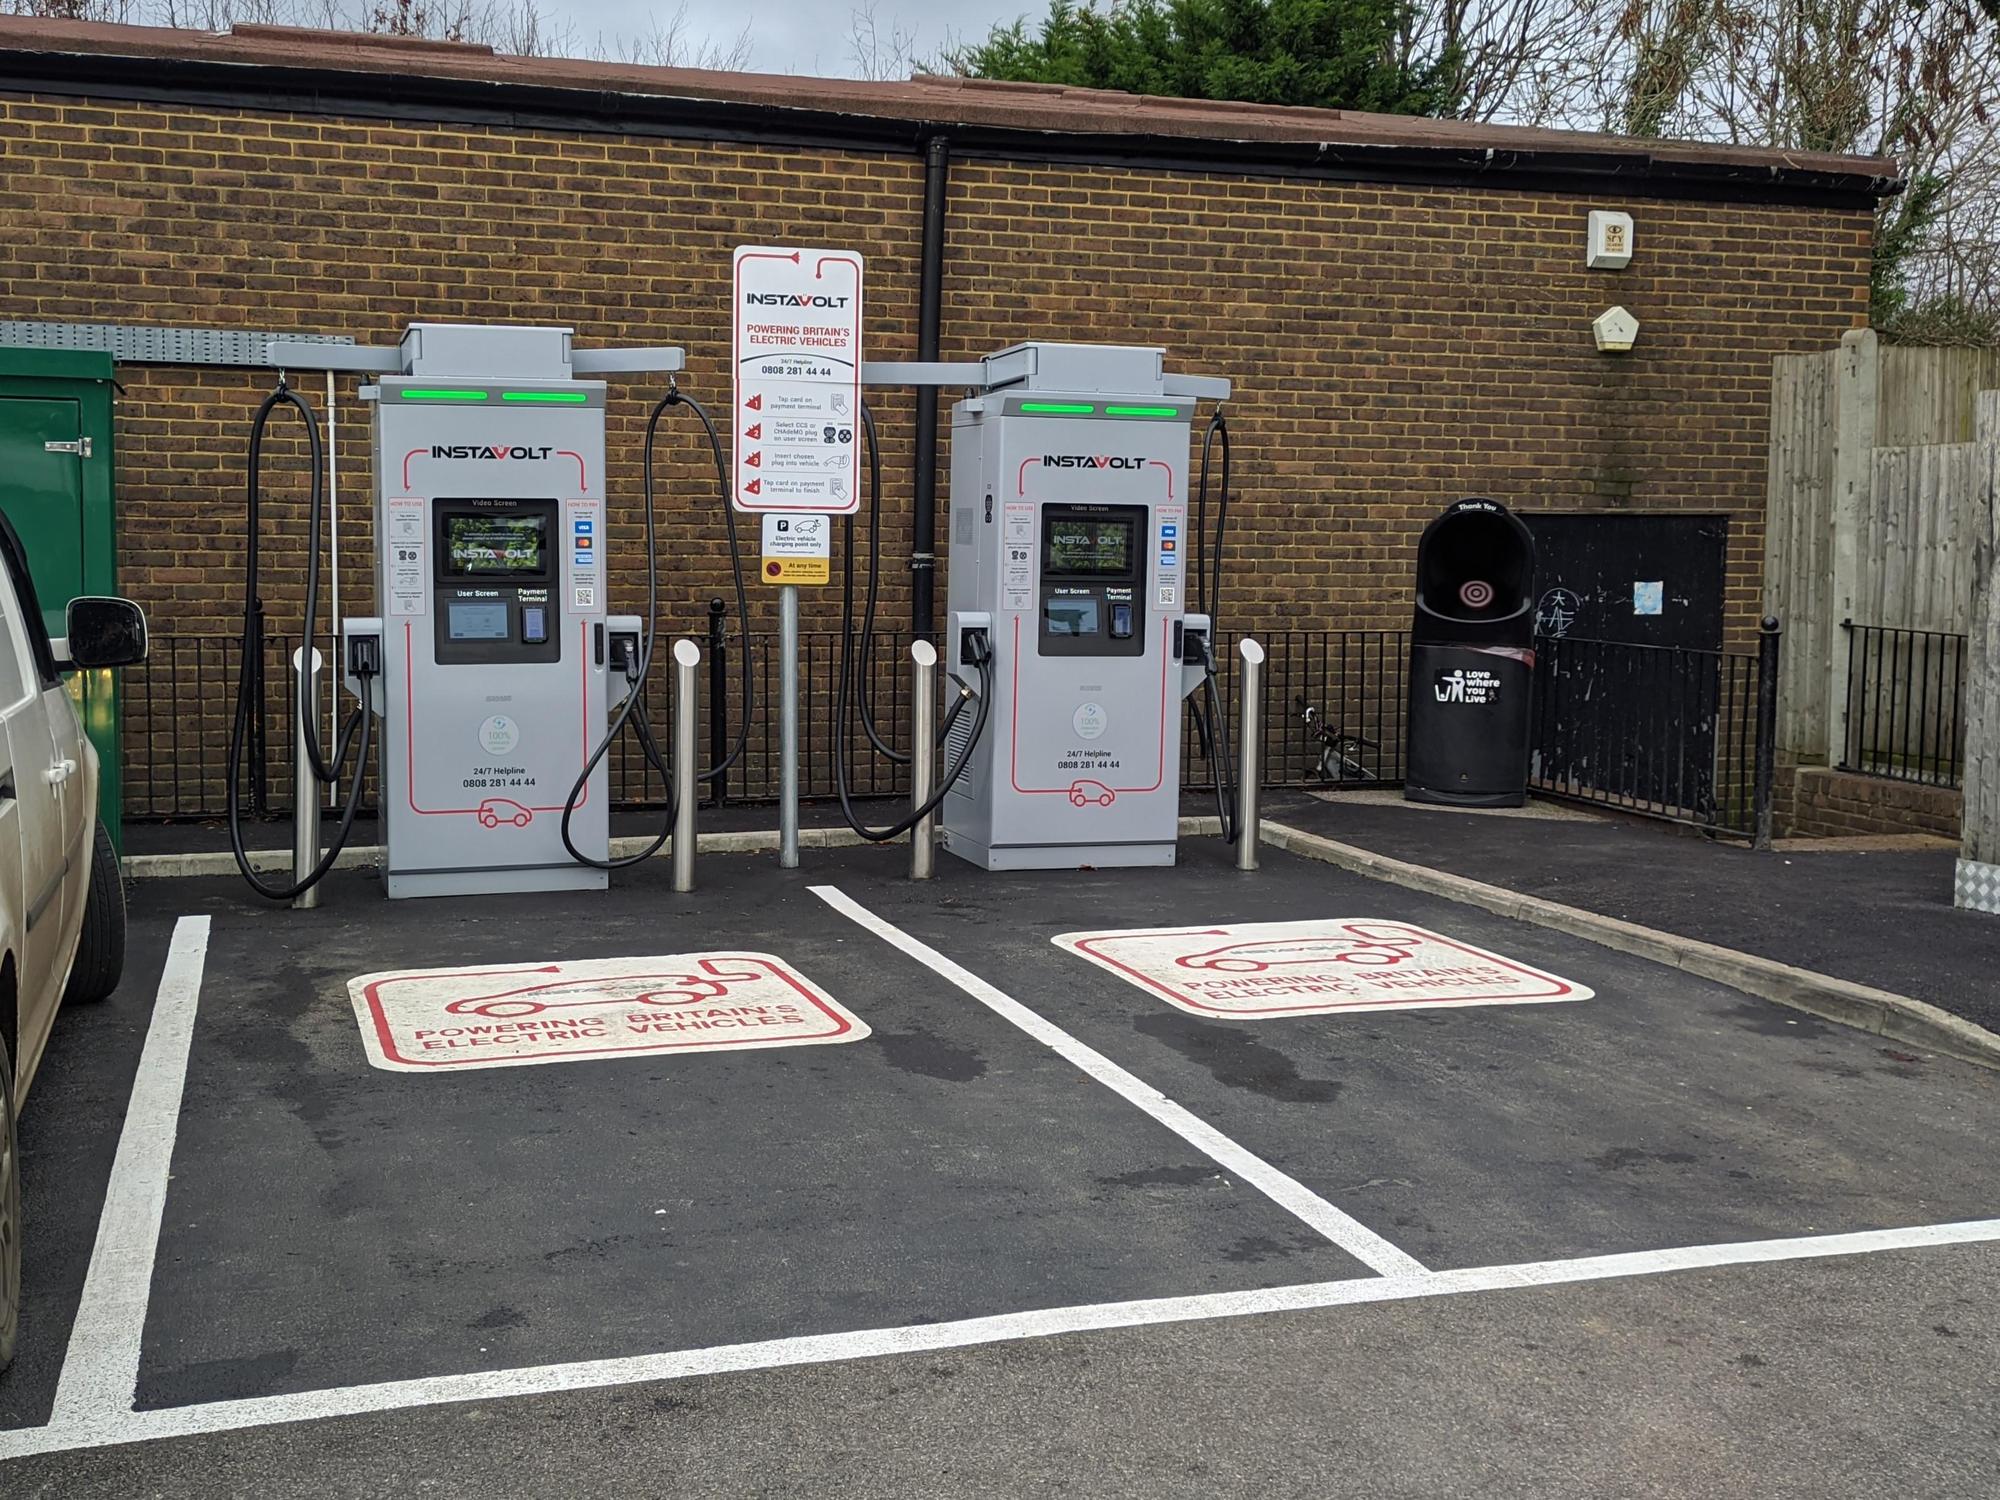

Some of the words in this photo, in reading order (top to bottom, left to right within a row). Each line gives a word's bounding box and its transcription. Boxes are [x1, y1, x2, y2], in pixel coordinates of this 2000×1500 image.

[746, 293, 849, 308] INSTAVOLT
[747, 324, 800, 335] POWERING
[803, 327, 850, 337] BRITAIN'S
[750, 335, 796, 345] ELECTRIC
[799, 337, 847, 347] VEHICLES
[761, 366, 784, 374] 0808
[787, 367, 802, 375] 281
[806, 367, 817, 375] 44
[820, 368, 831, 376] 44
[432, 445, 553, 460] INSTAVOLT
[1043, 455, 1146, 469] INSTAVOLT
[1458, 502, 1482, 510] Thank
[1483, 503, 1497, 511] You
[1053, 535, 1123, 545] INSTAVOLT
[453, 549, 534, 559] INSTAVOLT
[1466, 678, 1500, 687] where
[1084, 750, 1111, 758] Helpline
[1058, 761, 1078, 769] 0808
[1080, 761, 1095, 769] 281
[473, 767, 492, 775] 24/7
[494, 767, 526, 776] Helpline
[463, 779, 487, 788] 0808
[489, 778, 507, 787] 281
[509, 778, 521, 786] 44
[524, 778, 536, 786] 44
[1182, 974, 1344, 990] POWERING
[1354, 966, 1499, 980] BRITAIN'S
[1204, 983, 1359, 1000] ELECTRIC
[1368, 975, 1520, 989] VEHICLES
[414, 1017, 605, 1039] POWERING
[626, 1004, 797, 1023] BRITAIN'S
[422, 1028, 607, 1049] ELECTRIC
[627, 1015, 804, 1033] VEHICLES
